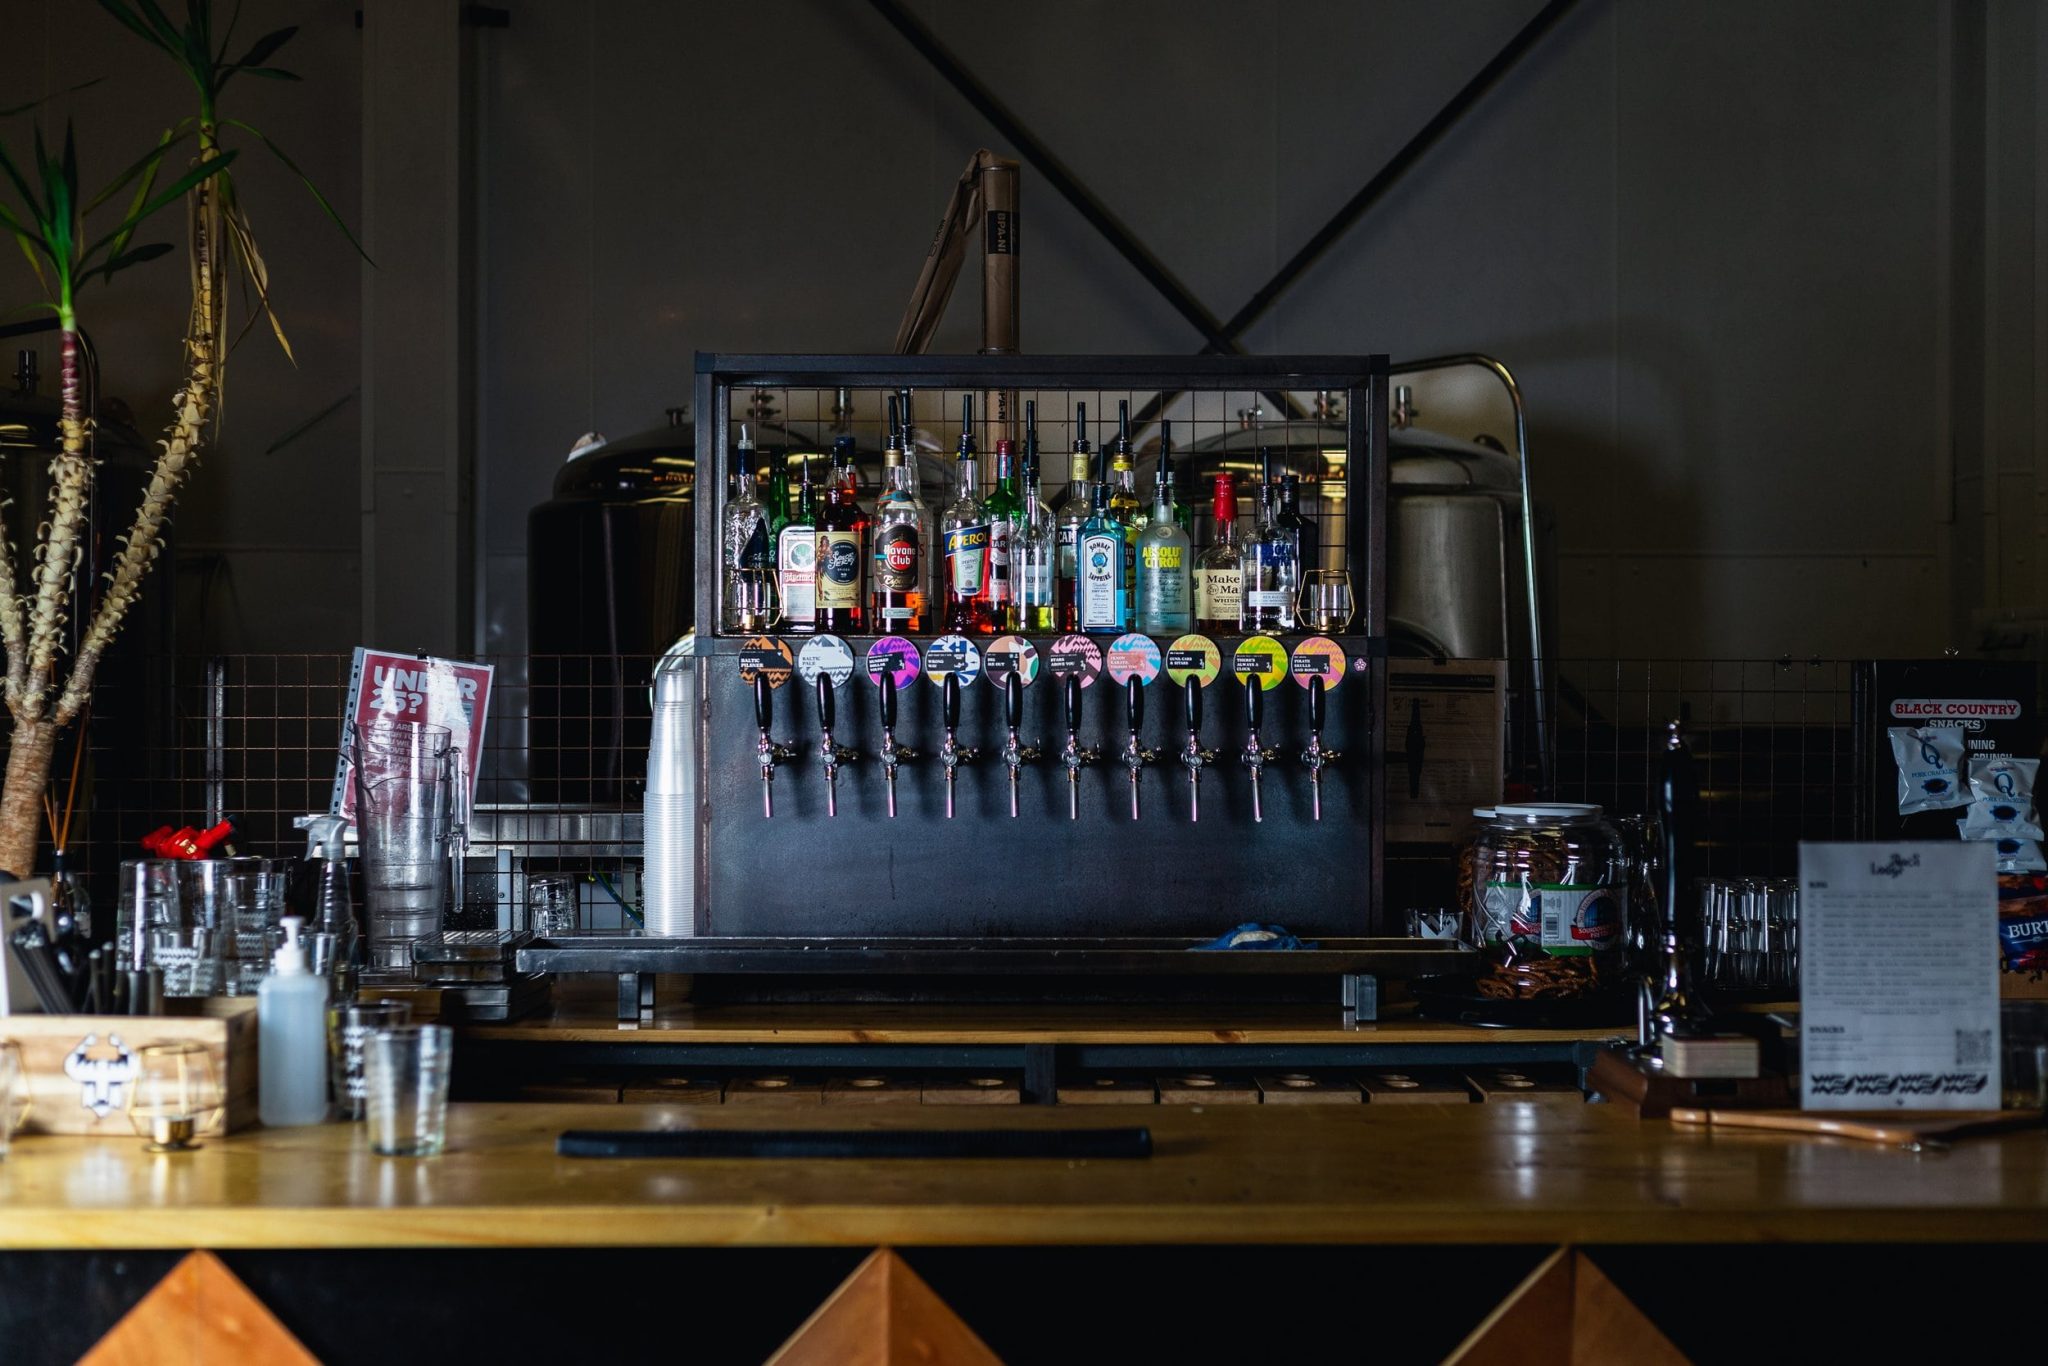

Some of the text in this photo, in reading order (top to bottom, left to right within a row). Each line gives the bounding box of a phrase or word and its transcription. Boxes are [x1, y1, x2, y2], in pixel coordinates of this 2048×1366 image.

[883, 544, 916, 555] Havana
[1089, 542, 1111, 552] BOMBAY
[890, 555, 911, 565] Club
[1144, 557, 1182, 568] CITRON
[1088, 572, 1112, 582] SAPPHIRE
[1206, 575, 1240, 584] Make
[1220, 585, 1241, 594] Ma
[373, 665, 478, 700] UNDR
[1895, 703, 2018, 715] BLACK COUNTRY
[1929, 719, 1981, 730] SNACKS
[1968, 739, 1996, 750] NING
[1921, 743, 1943, 769] Q
[1994, 773, 2015, 798] Q
